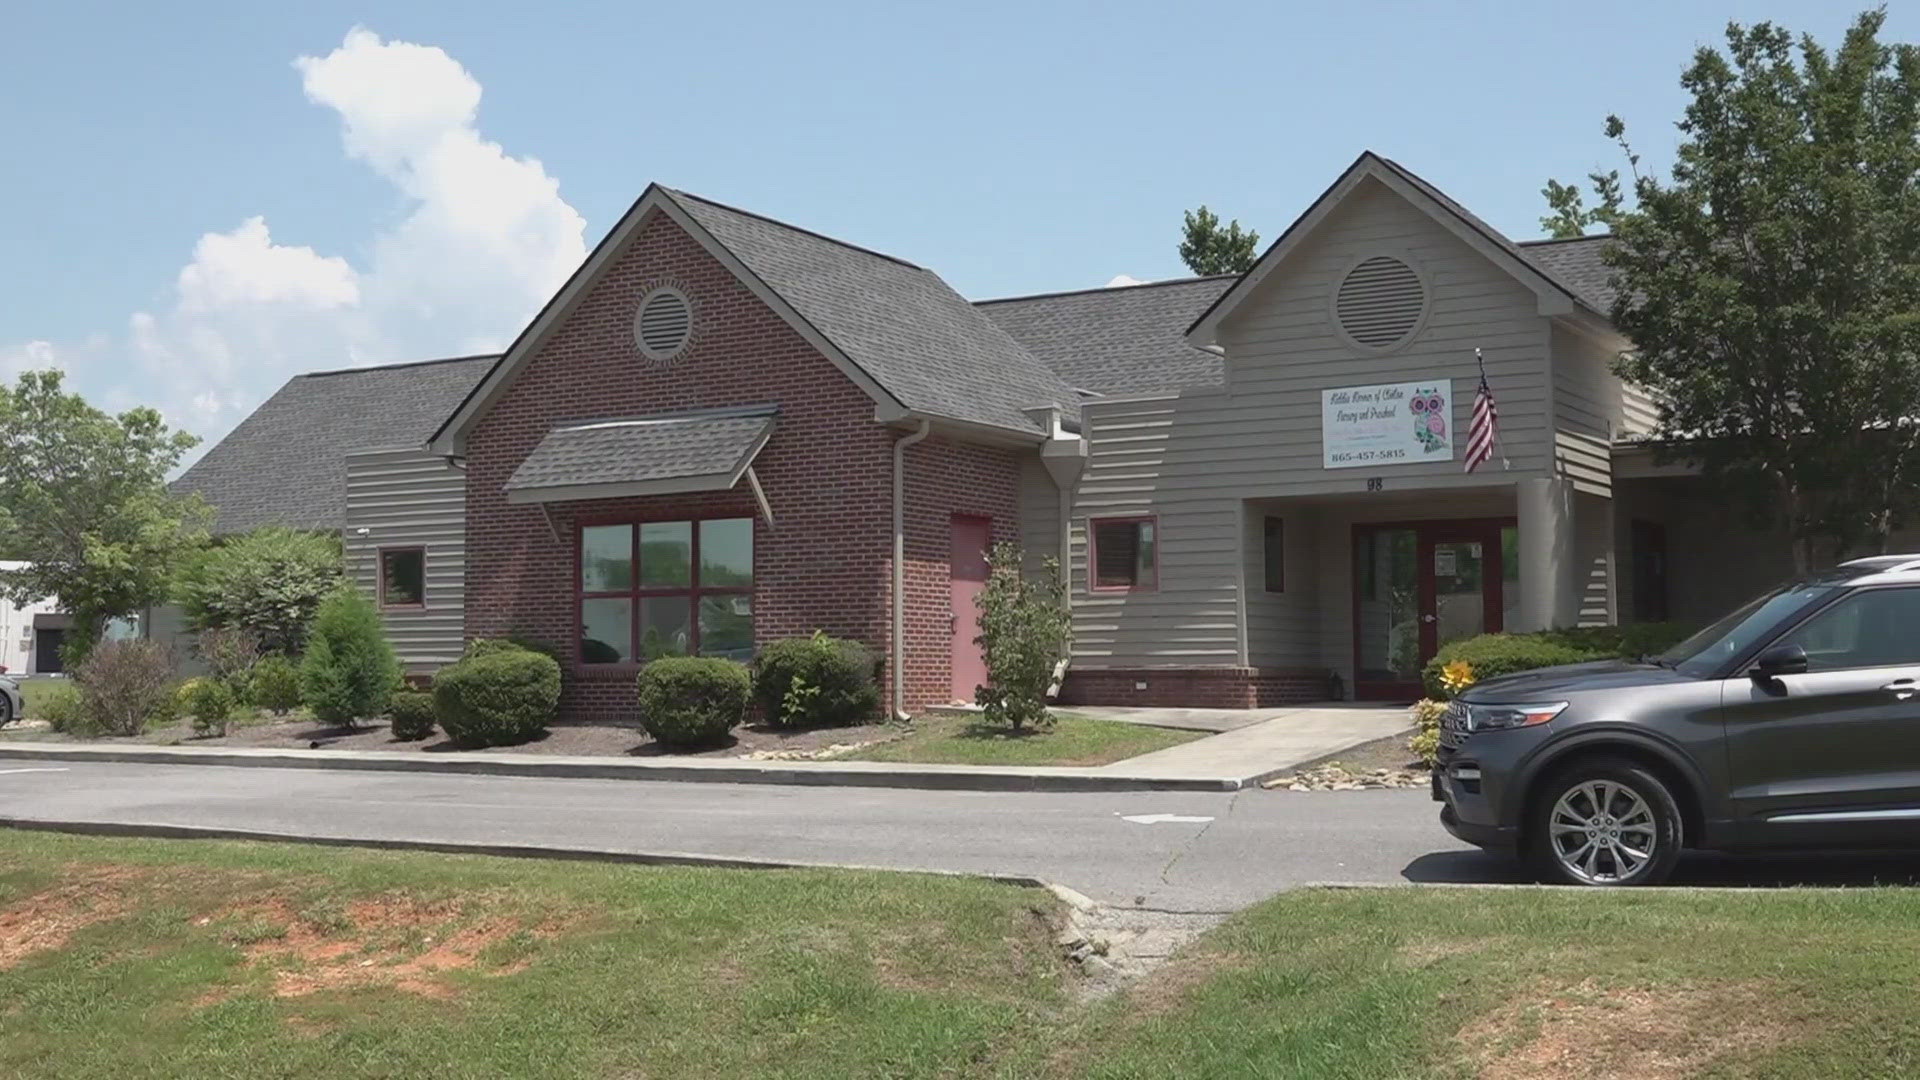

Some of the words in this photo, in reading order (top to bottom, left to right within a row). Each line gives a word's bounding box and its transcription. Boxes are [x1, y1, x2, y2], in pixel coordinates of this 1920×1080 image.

[1373, 388, 1382, 404] of
[1331, 449, 1405, 462] 865-457-5815
[1367, 477, 1383, 491] 98
